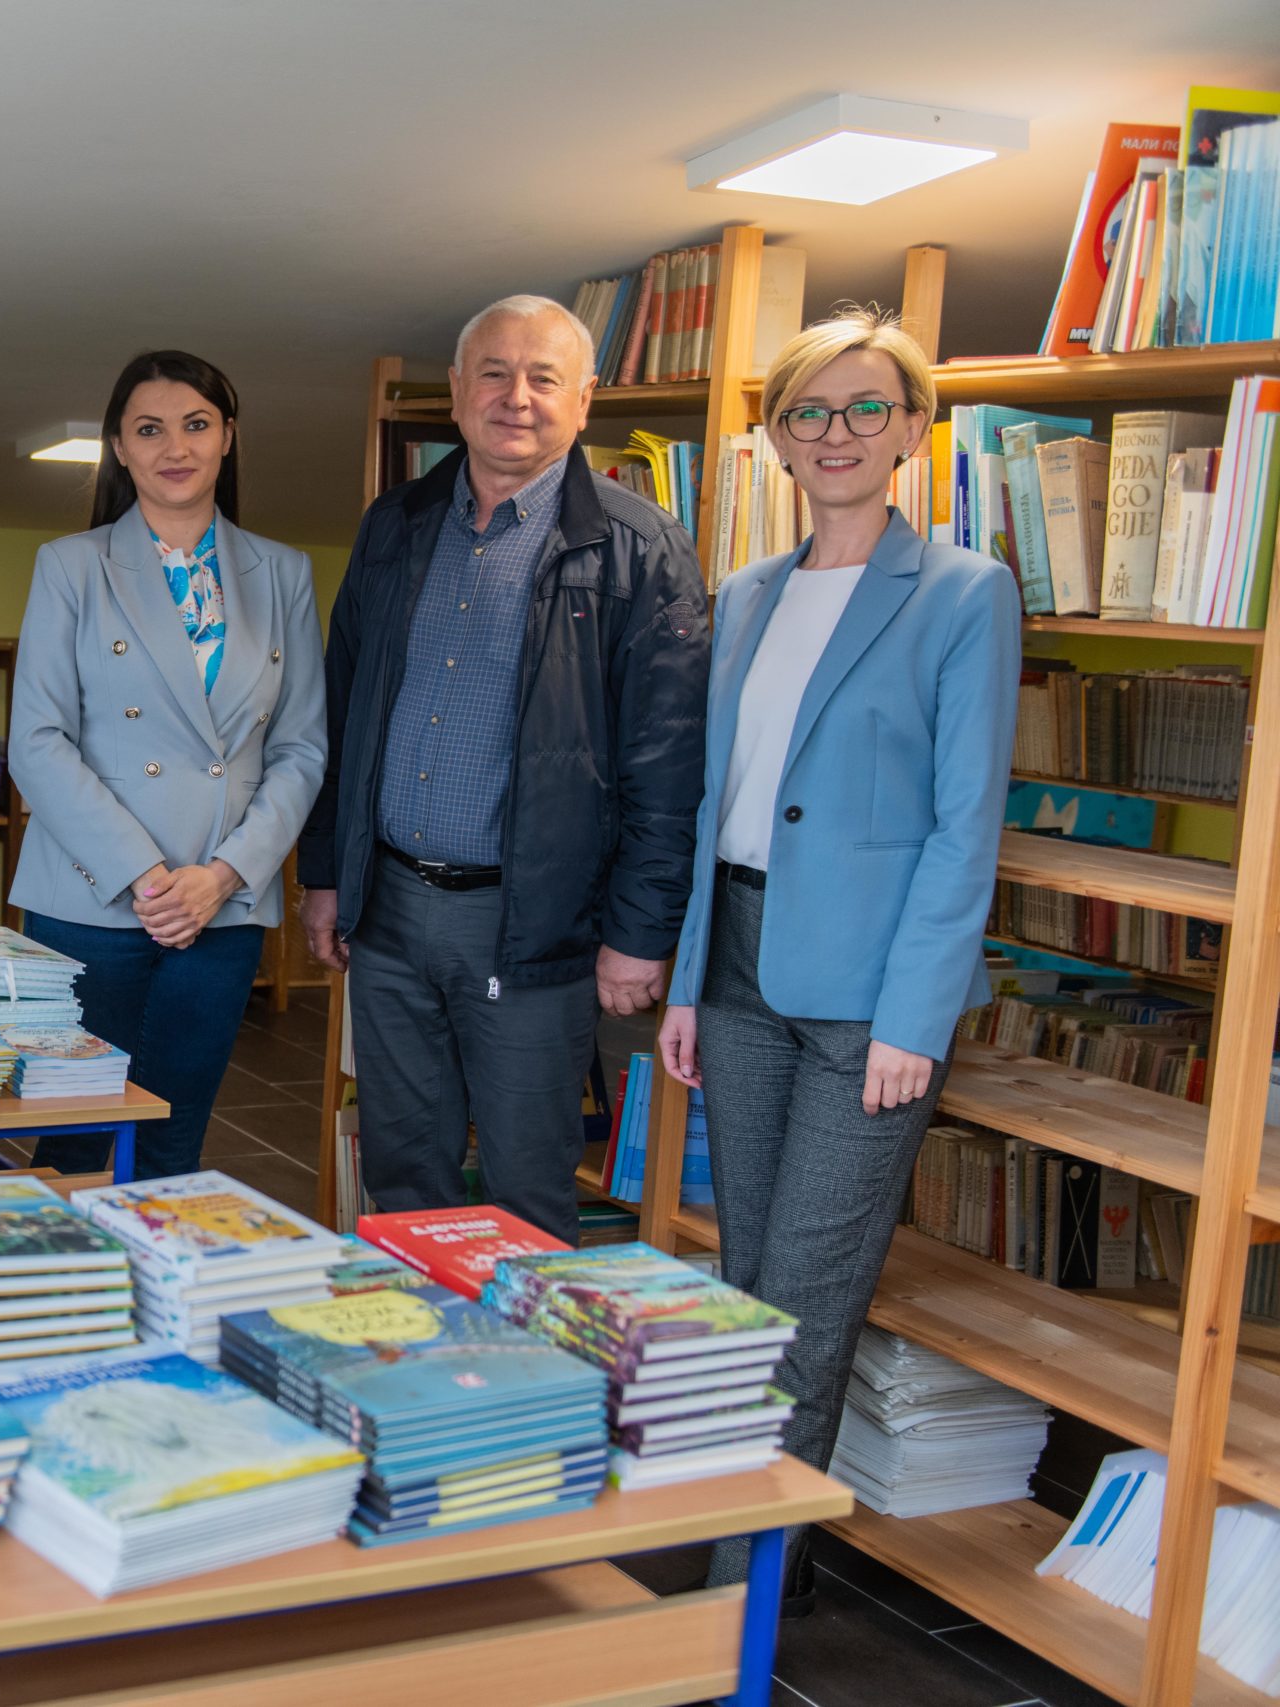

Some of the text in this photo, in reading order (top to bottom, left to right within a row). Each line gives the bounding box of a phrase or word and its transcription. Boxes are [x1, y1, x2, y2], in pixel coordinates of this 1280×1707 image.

[1120, 137, 1159, 151] МАЛИ
[1114, 430, 1162, 449] RJEČNIK
[1111, 455, 1161, 480] PEDA
[1112, 484, 1151, 508] GO
[1108, 510, 1156, 539] GIJE
